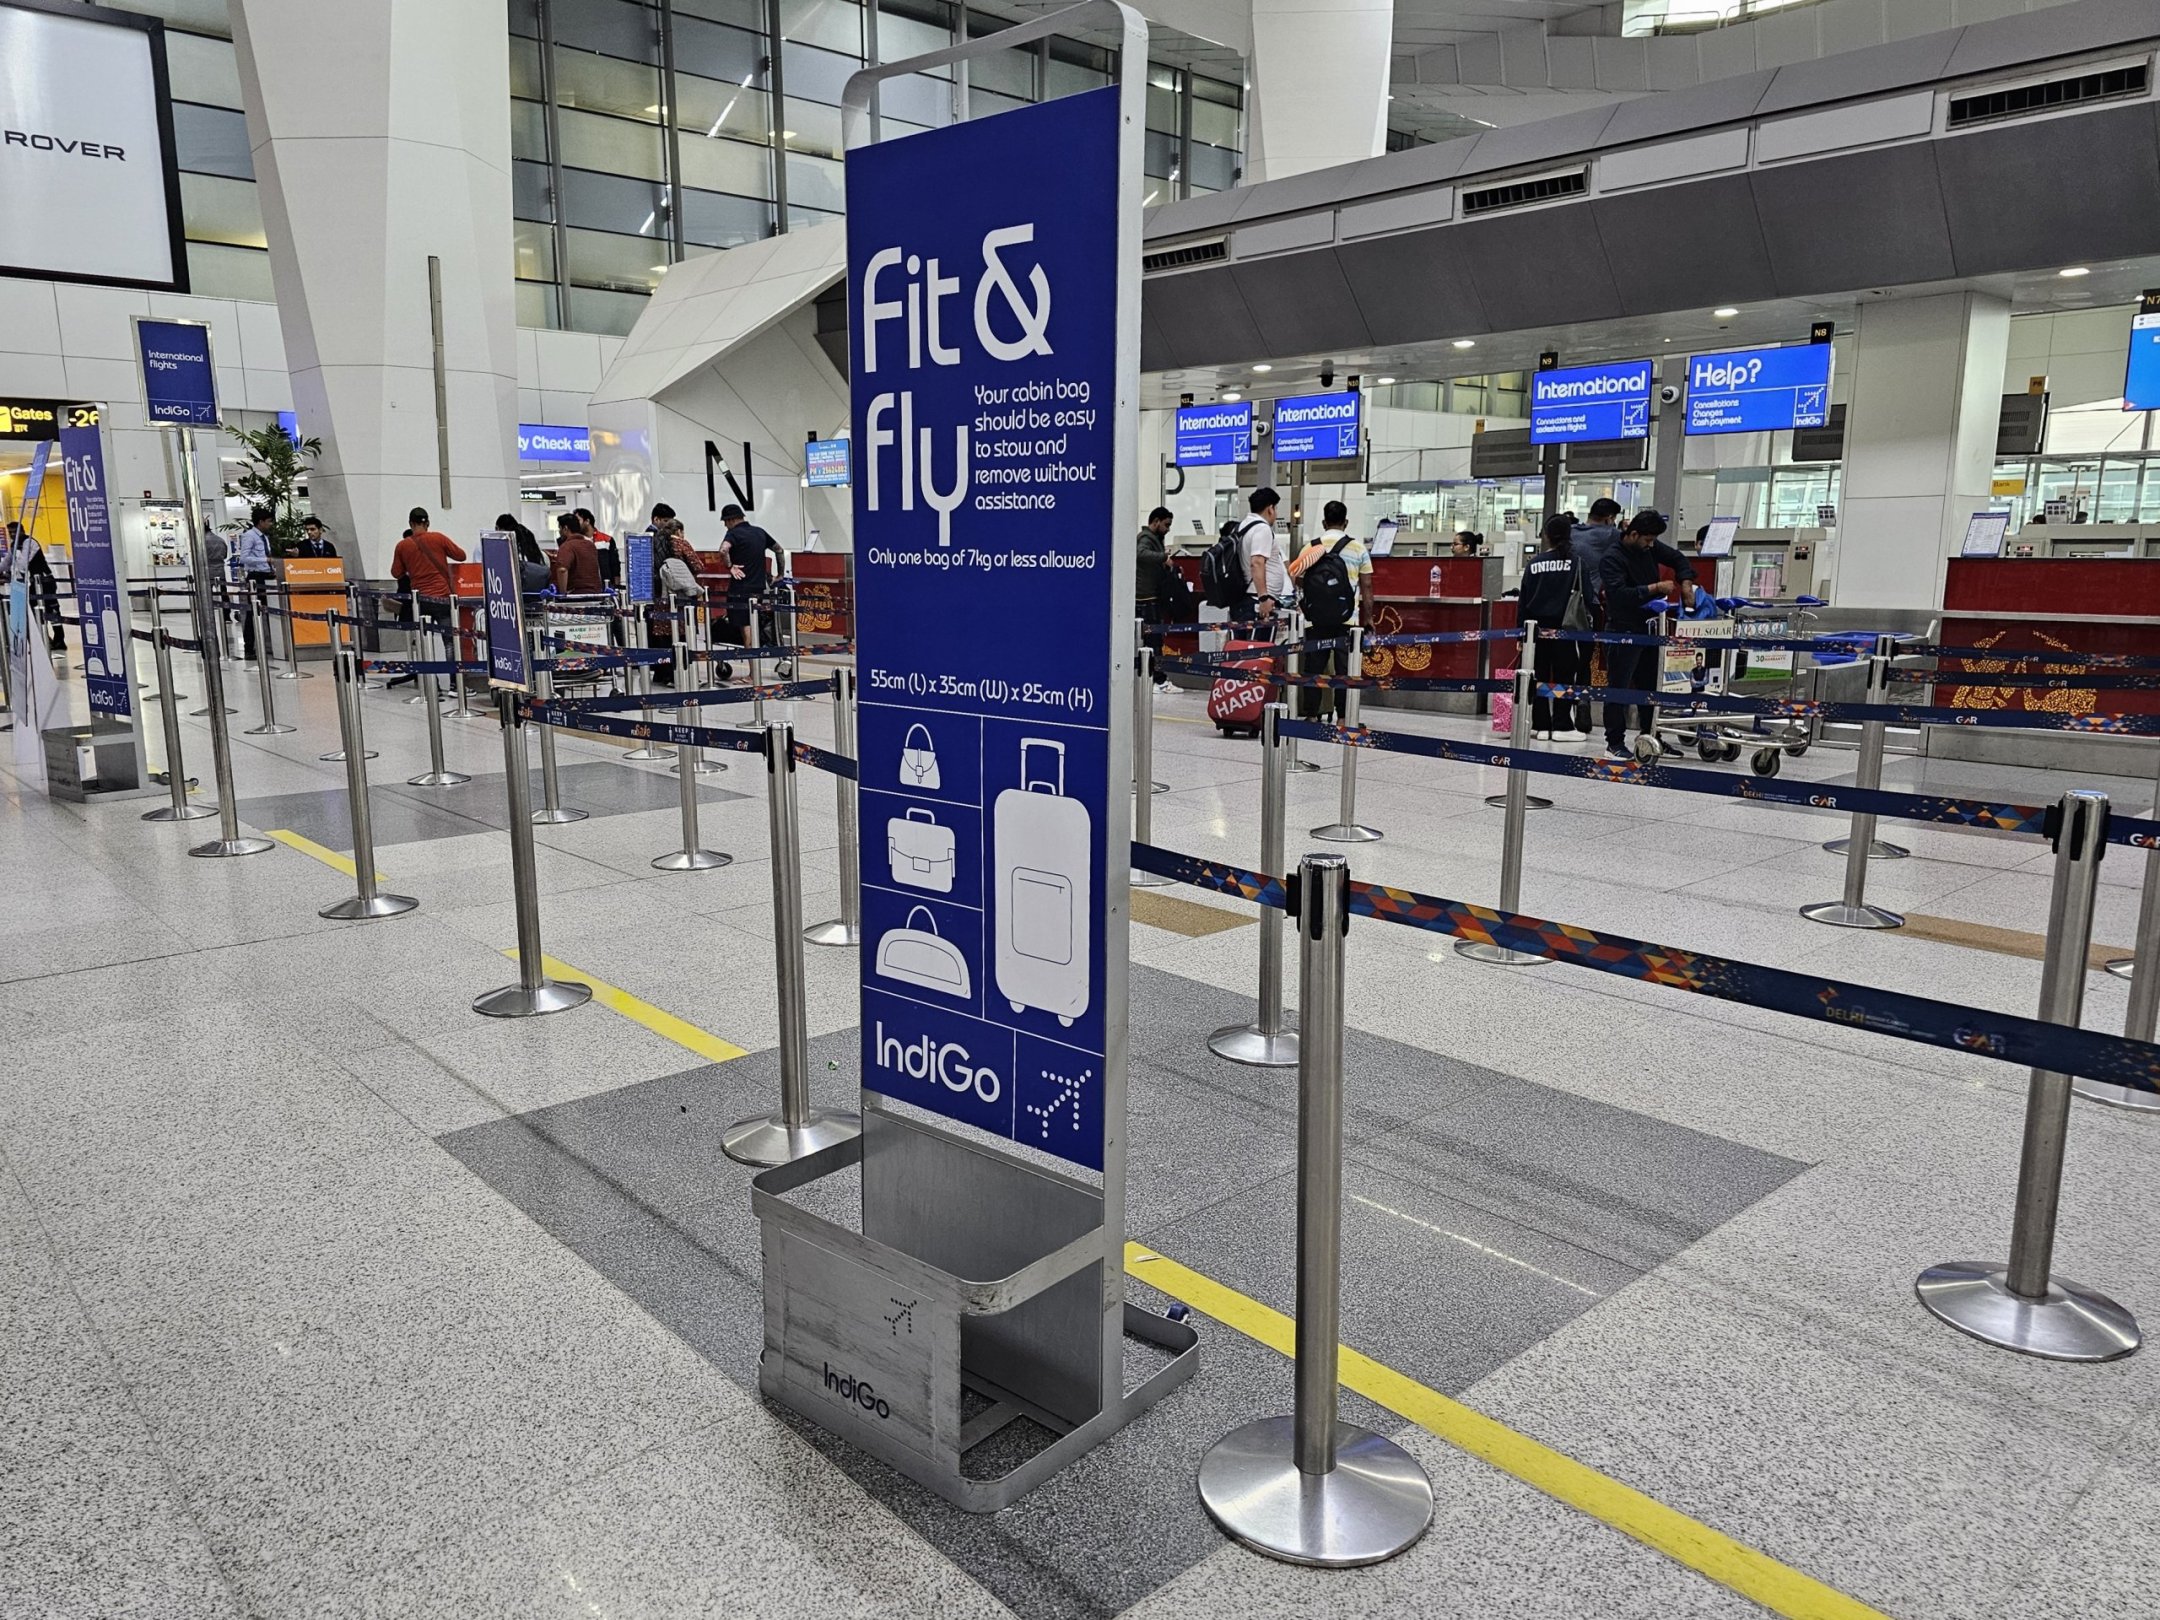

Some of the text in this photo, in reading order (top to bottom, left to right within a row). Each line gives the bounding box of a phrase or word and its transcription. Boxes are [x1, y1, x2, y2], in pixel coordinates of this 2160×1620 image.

[4, 130, 126, 162] ROVER
[864, 222, 1054, 373] Fit &
[1814, 328, 1827, 337] N8
[148, 350, 204, 362] International
[1542, 358, 1552, 366] N9
[1538, 370, 1646, 400] International
[1694, 358, 1762, 392] Help?
[974, 378, 1090, 405] Your cabin bag
[11, 407, 54, 420] Gates
[154, 404, 190, 416] IndiGo
[974, 408, 1096, 432] should be easy
[1180, 410, 1248, 431] International
[1278, 400, 1356, 423] International
[1572, 414, 1586, 422] and
[1692, 408, 1724, 418] Changes
[1692, 416, 1742, 427] Cash payment
[1796, 416, 1821, 426] IndiGo
[532, 435, 573, 450] Check
[1624, 428, 1646, 436] IndiGo
[975, 433, 1067, 458] to stow and
[65, 454, 98, 492] Fit &
[705, 440, 754, 512] N
[866, 391, 968, 546] fly
[975, 461, 1096, 484] remove without
[974, 492, 1056, 510] assistance
[70, 497, 89, 542] fly
[868, 548, 1096, 572] Only one bag of 7kg or less allowed
[1530, 558, 1572, 576] UNIQUE
[488, 568, 502, 595] No
[490, 597, 516, 628] entry
[1704, 626, 1732, 636] SOLAR
[494, 655, 512, 672] IndiGo
[90, 688, 114, 706] IndiGo
[871, 669, 1094, 712] 55cm (L) x 35cm (W) x 25cm (H)
[1216, 686, 1266, 718] HARD
[674, 726, 689, 734] KEEP
[1826, 1006, 1864, 1024] DELHI
[876, 1020, 1000, 1103] IndiGo
[824, 1362, 890, 1419] IndiGo
